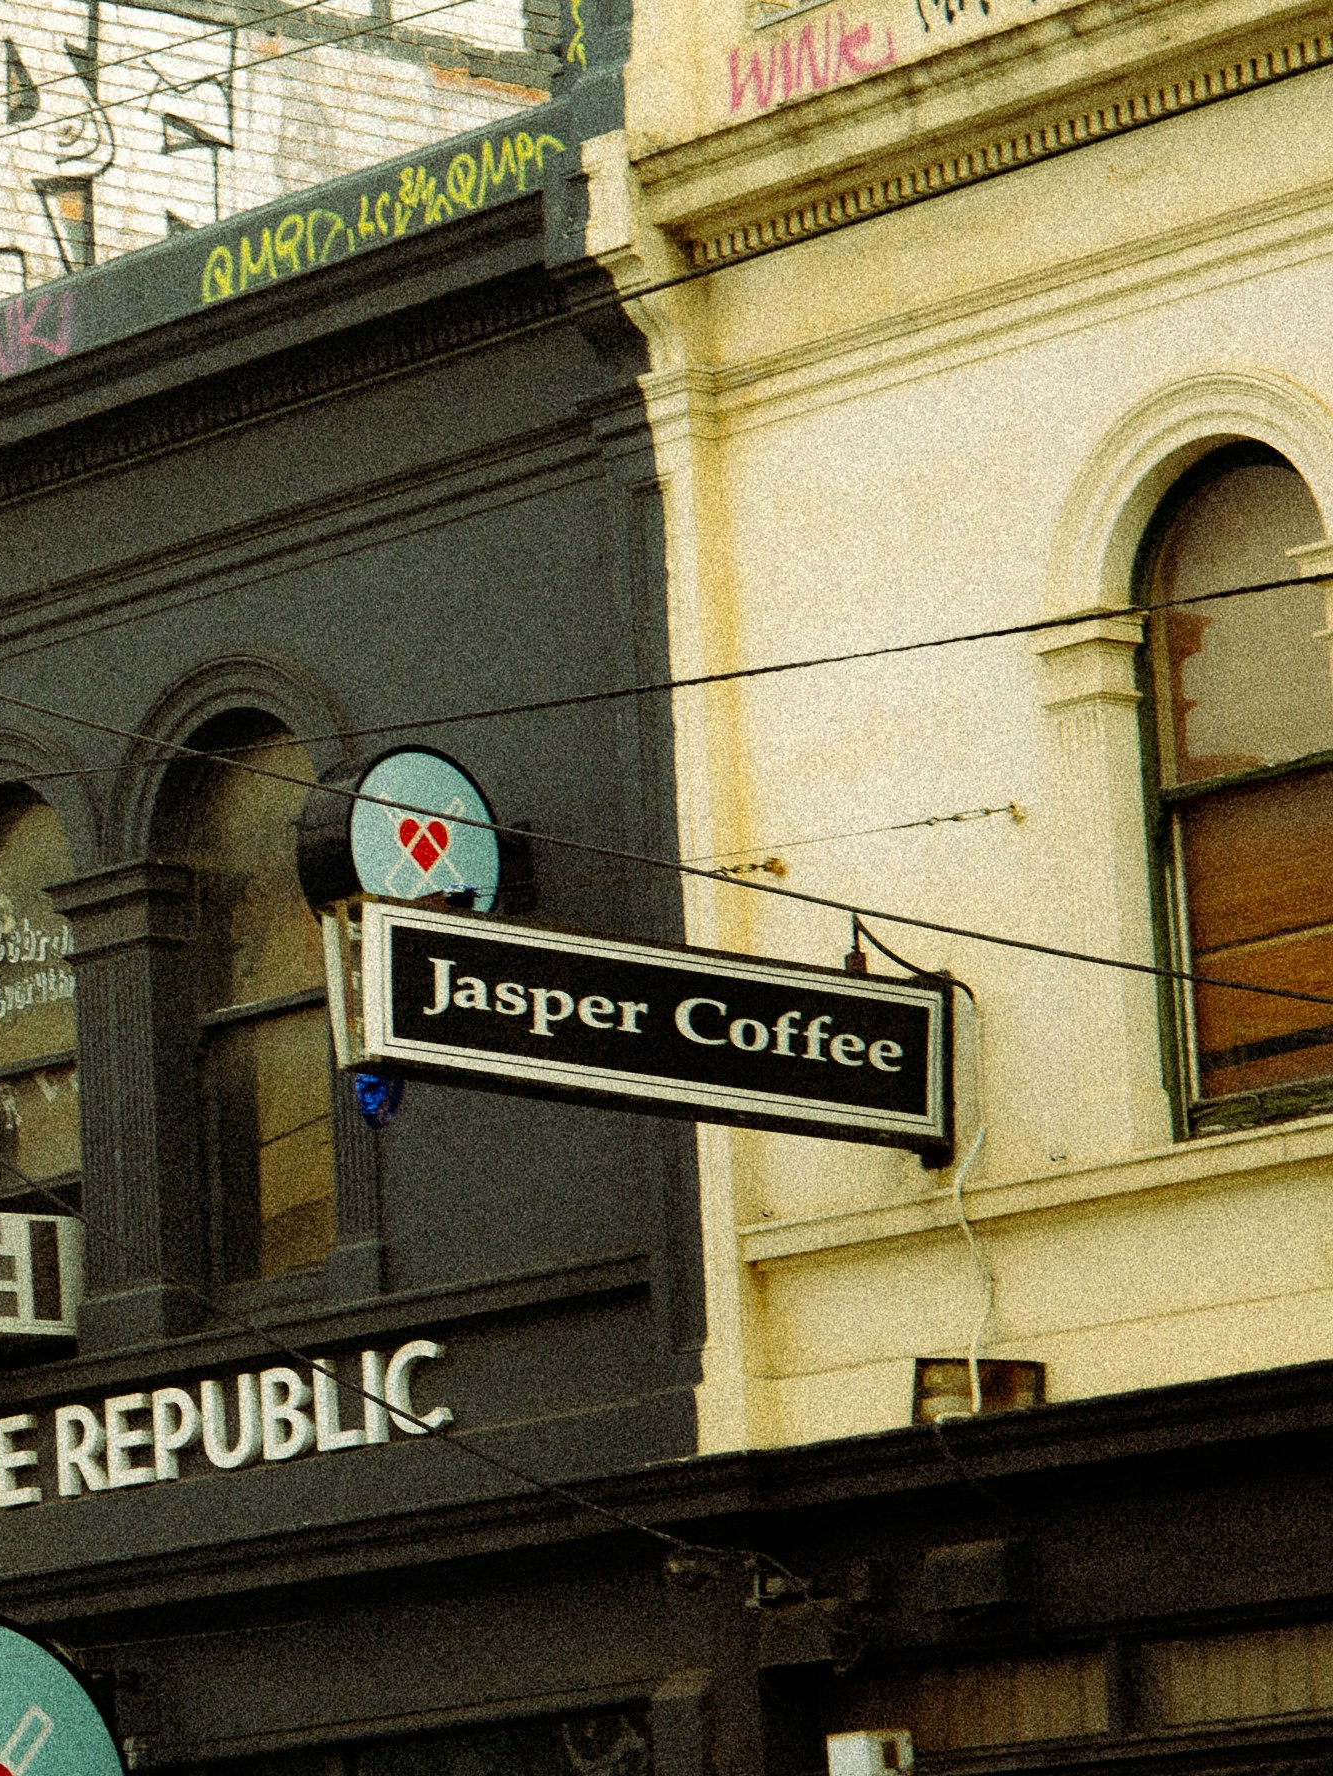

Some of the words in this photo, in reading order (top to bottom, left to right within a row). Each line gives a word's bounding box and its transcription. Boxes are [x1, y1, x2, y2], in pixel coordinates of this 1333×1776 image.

[422, 957, 648, 1036] Jasper
[674, 997, 904, 1073] Coffee
[56, 1340, 453, 1496] REPUBLIC
